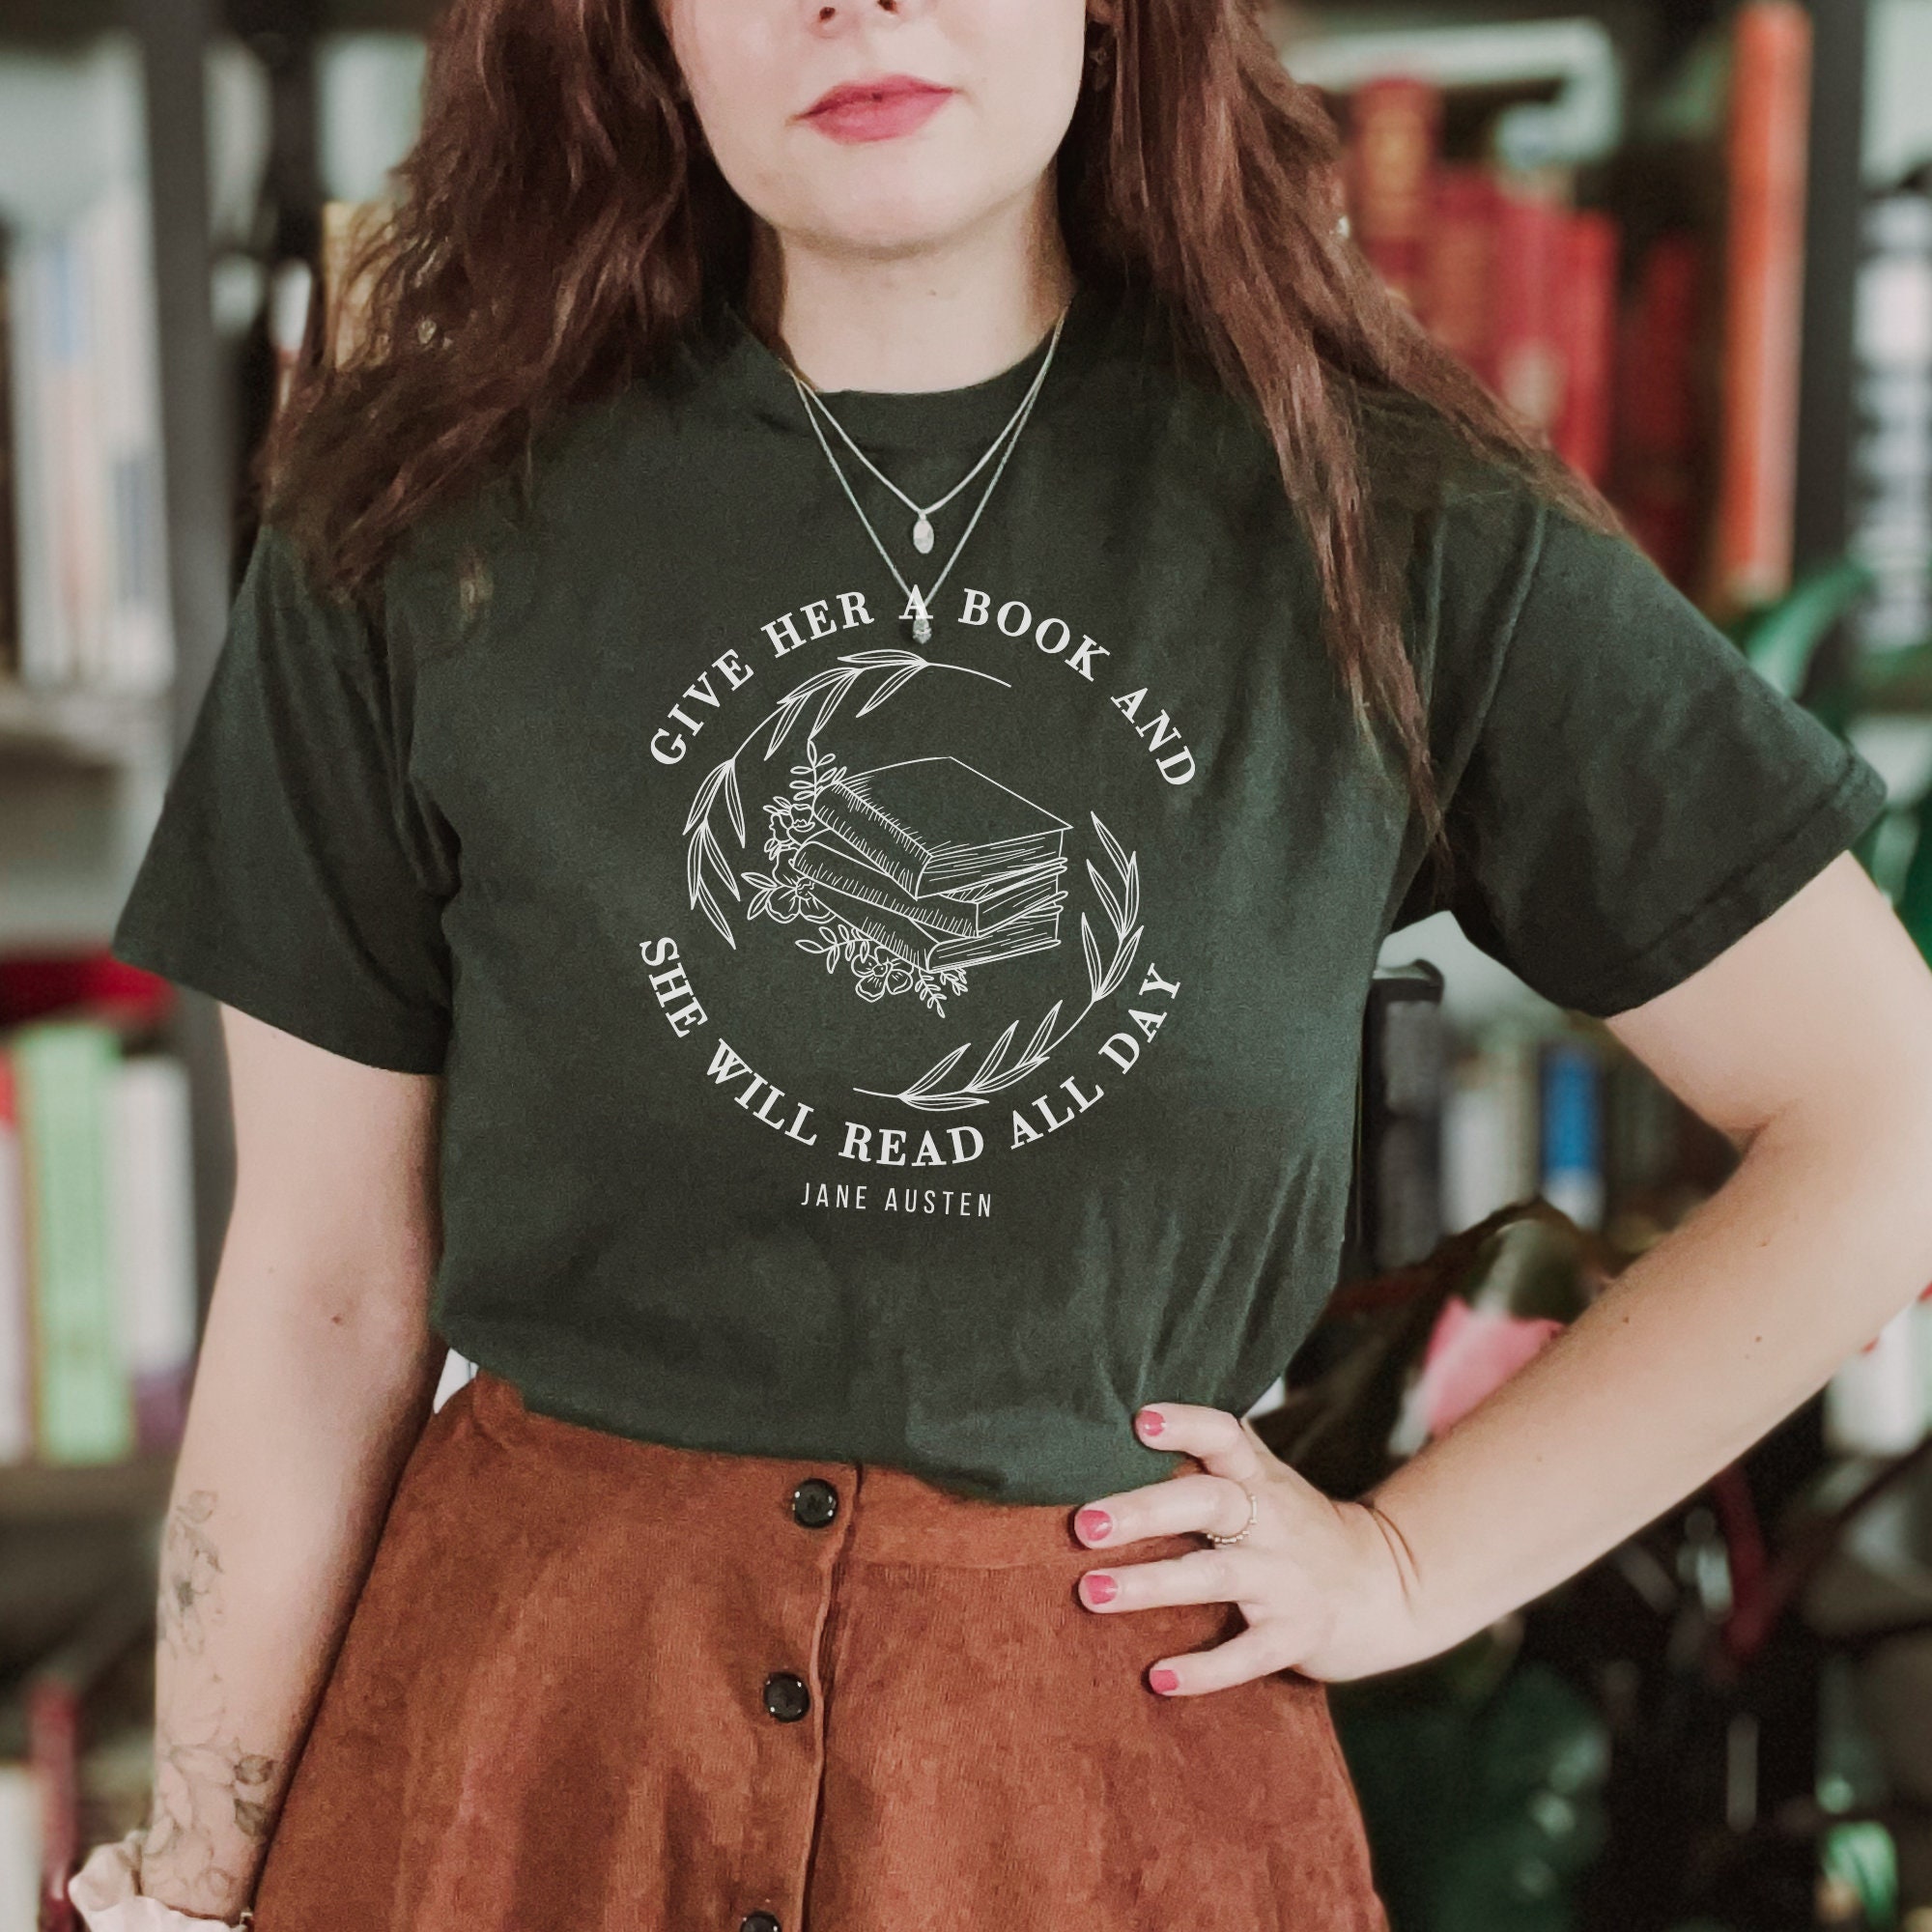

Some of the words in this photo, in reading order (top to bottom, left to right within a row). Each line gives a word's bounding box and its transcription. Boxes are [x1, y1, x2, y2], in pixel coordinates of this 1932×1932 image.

[650, 648, 754, 765] GIVE
[760, 591, 875, 659] HER
[898, 583, 934, 620] A
[957, 587, 1111, 683] BOOK
[1110, 687, 1196, 785] AND
[639, 935, 709, 1038] SHE
[706, 1037, 818, 1147] WILL
[838, 1121, 984, 1167] READ
[1009, 1075, 1105, 1151] ALL
[1097, 962, 1181, 1075] DAY
[801, 1182, 868, 1209] JANE
[884, 1187, 992, 1217] AUSTEN
